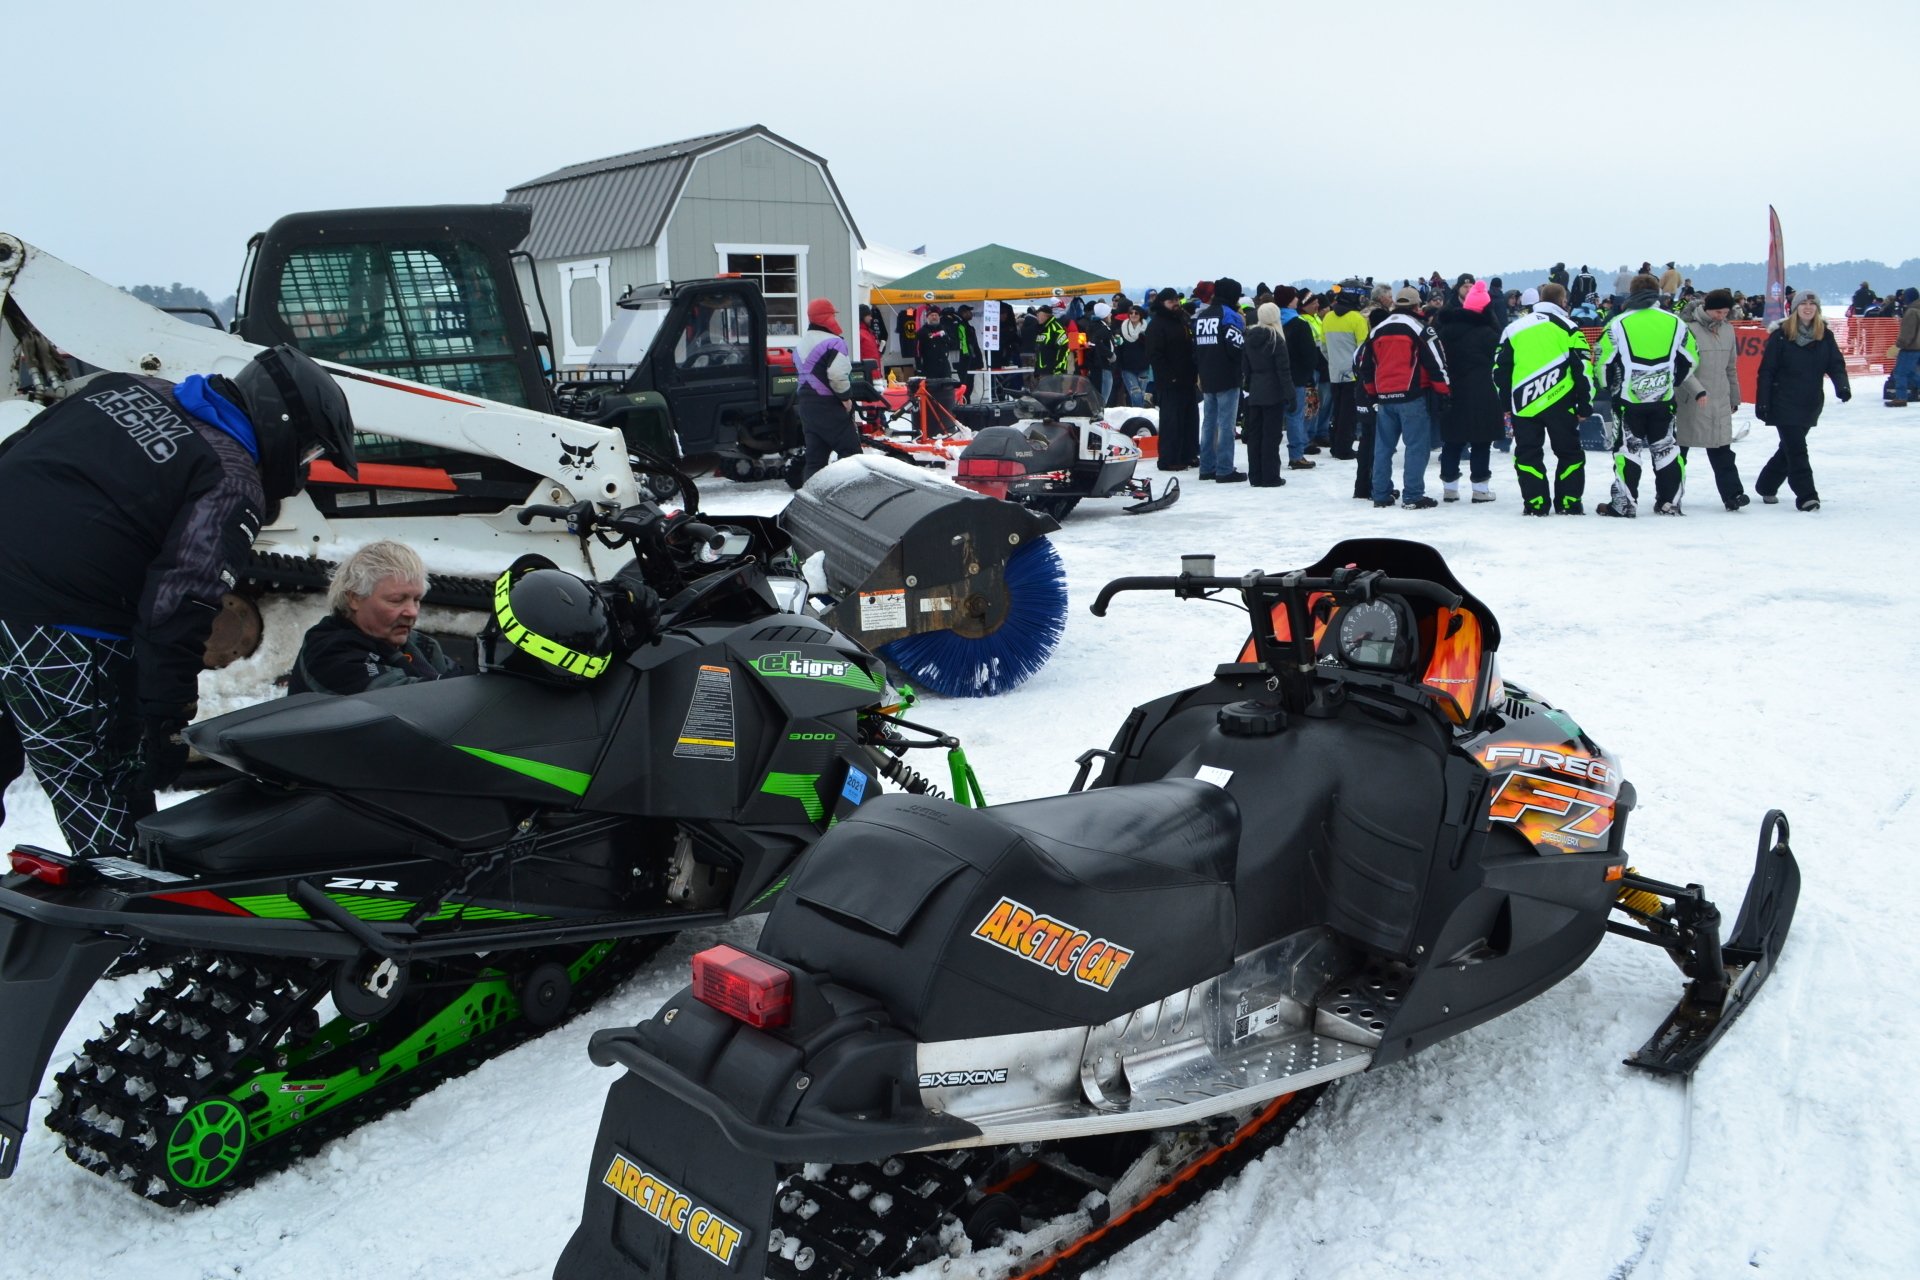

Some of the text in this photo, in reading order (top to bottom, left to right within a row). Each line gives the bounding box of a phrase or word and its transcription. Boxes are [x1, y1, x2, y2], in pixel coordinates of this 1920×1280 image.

[1196, 318, 1220, 335] FXR
[1521, 368, 1560, 408] FXR
[1637, 374, 1667, 390] FXR
[119, 384, 194, 440] TEAM
[84, 389, 178, 464] ARCTIC
[757, 651, 801, 672] el
[846, 776, 864, 793] 2021
[1540, 830, 1580, 847] SPEEDWERX
[324, 877, 399, 892] ZR
[971, 896, 1135, 992] ARCTIC CAT
[918, 1068, 1008, 1089] SIXSIXONE
[602, 1152, 743, 1266] ARCTIC CAT
